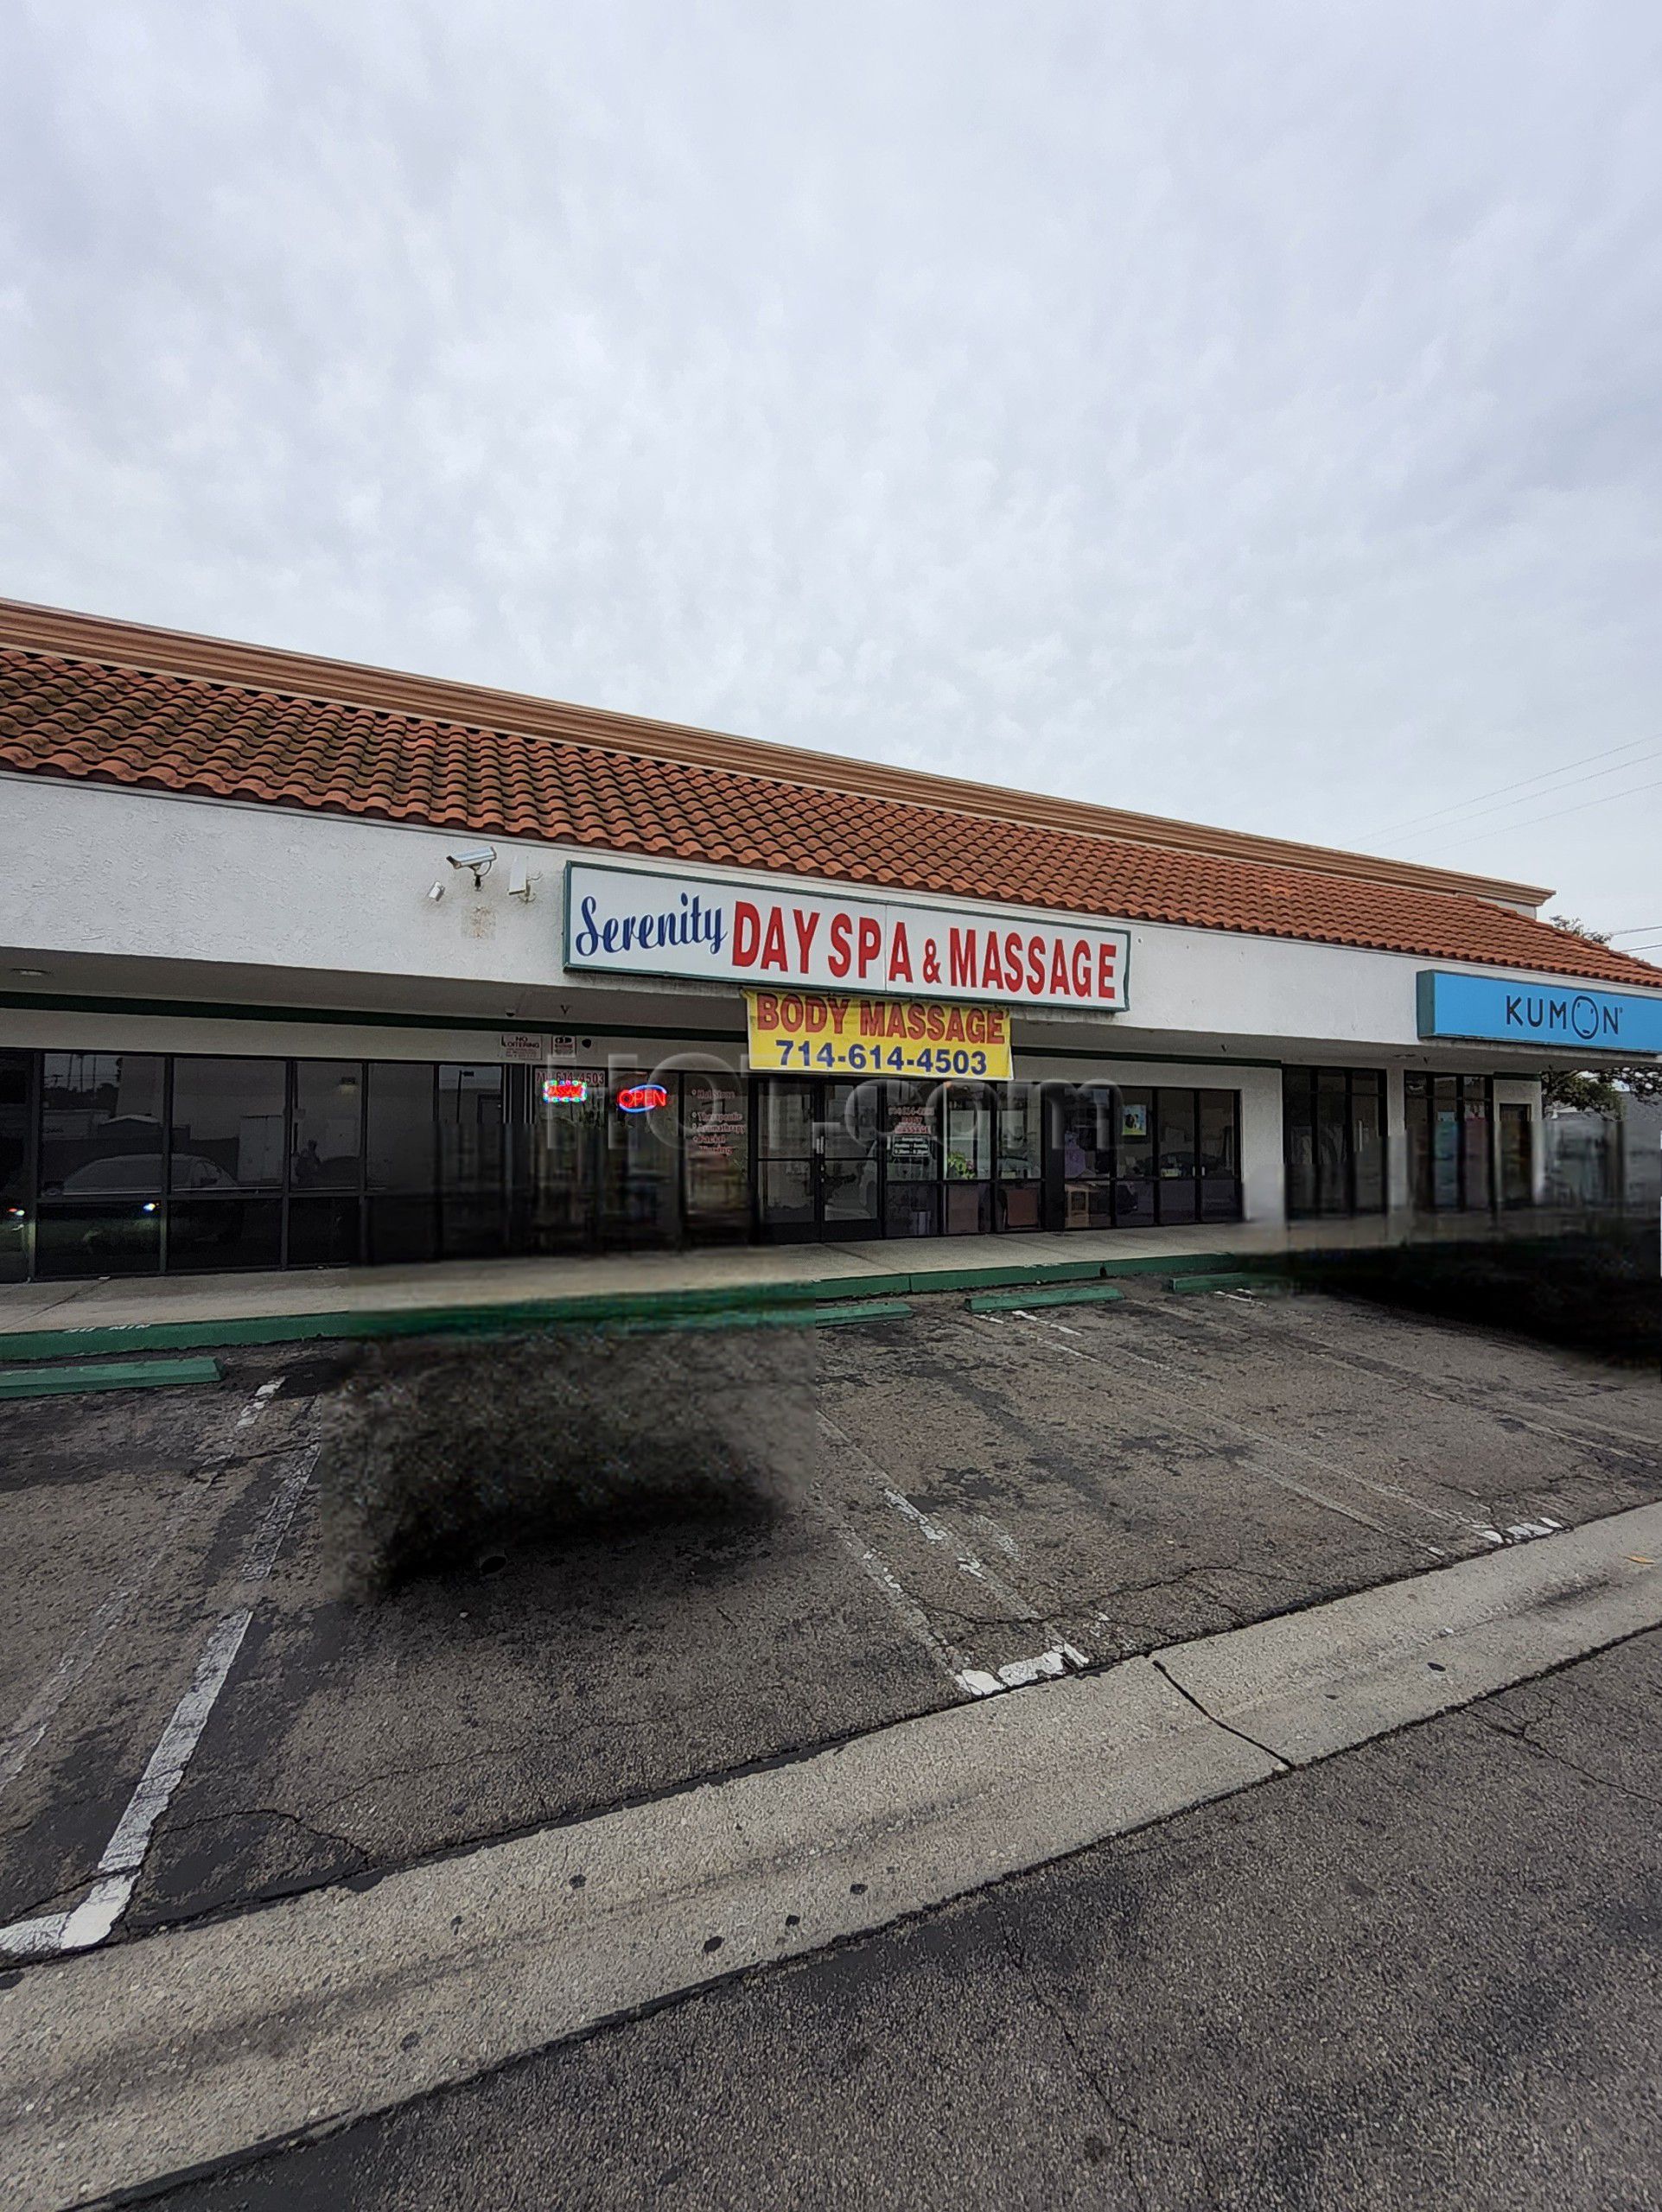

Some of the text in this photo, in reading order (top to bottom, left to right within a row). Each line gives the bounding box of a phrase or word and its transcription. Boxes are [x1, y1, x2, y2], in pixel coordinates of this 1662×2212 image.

[576, 892, 1117, 999] Serenity DAY SPA & MASSAGE
[757, 994, 1005, 1044] BODY MASSAGE
[776, 1039, 987, 1075] 714-614-4503
[618, 1090, 666, 1107] OPEN
